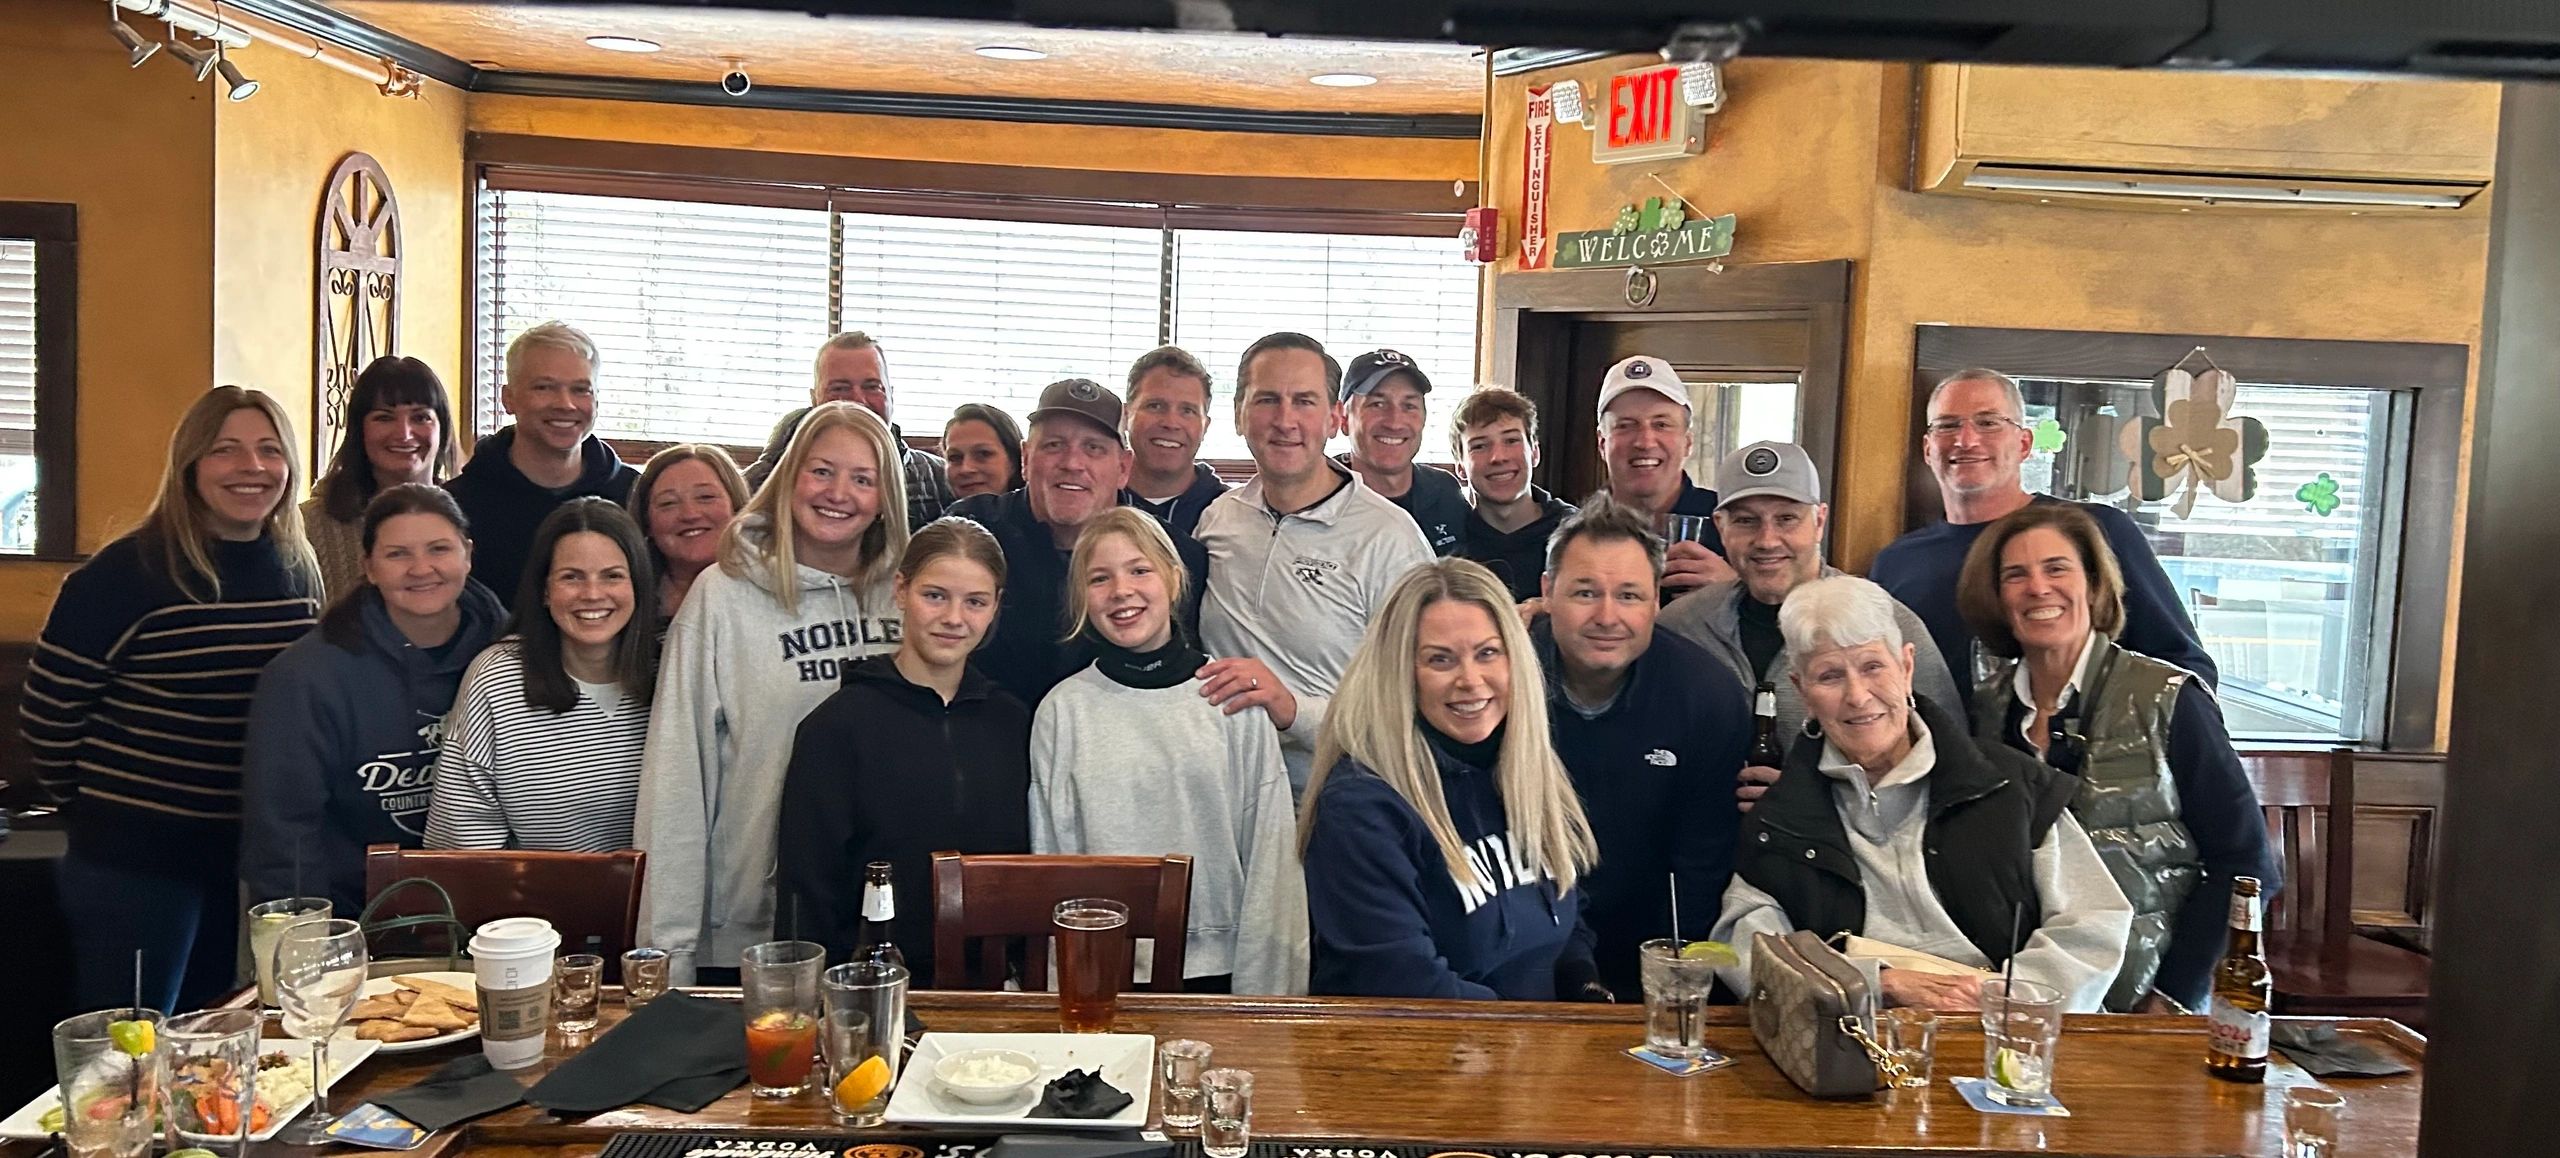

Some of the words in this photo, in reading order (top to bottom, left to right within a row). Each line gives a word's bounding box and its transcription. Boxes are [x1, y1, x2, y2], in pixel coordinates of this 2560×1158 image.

[1529, 99, 1549, 118] FIRE
[1609, 68, 1680, 147] EXIT
[1530, 125, 1543, 257] EXTINGUISHER
[714, 1140, 817, 1151] VODKA
[1293, 1148, 1398, 1158] VODKA
